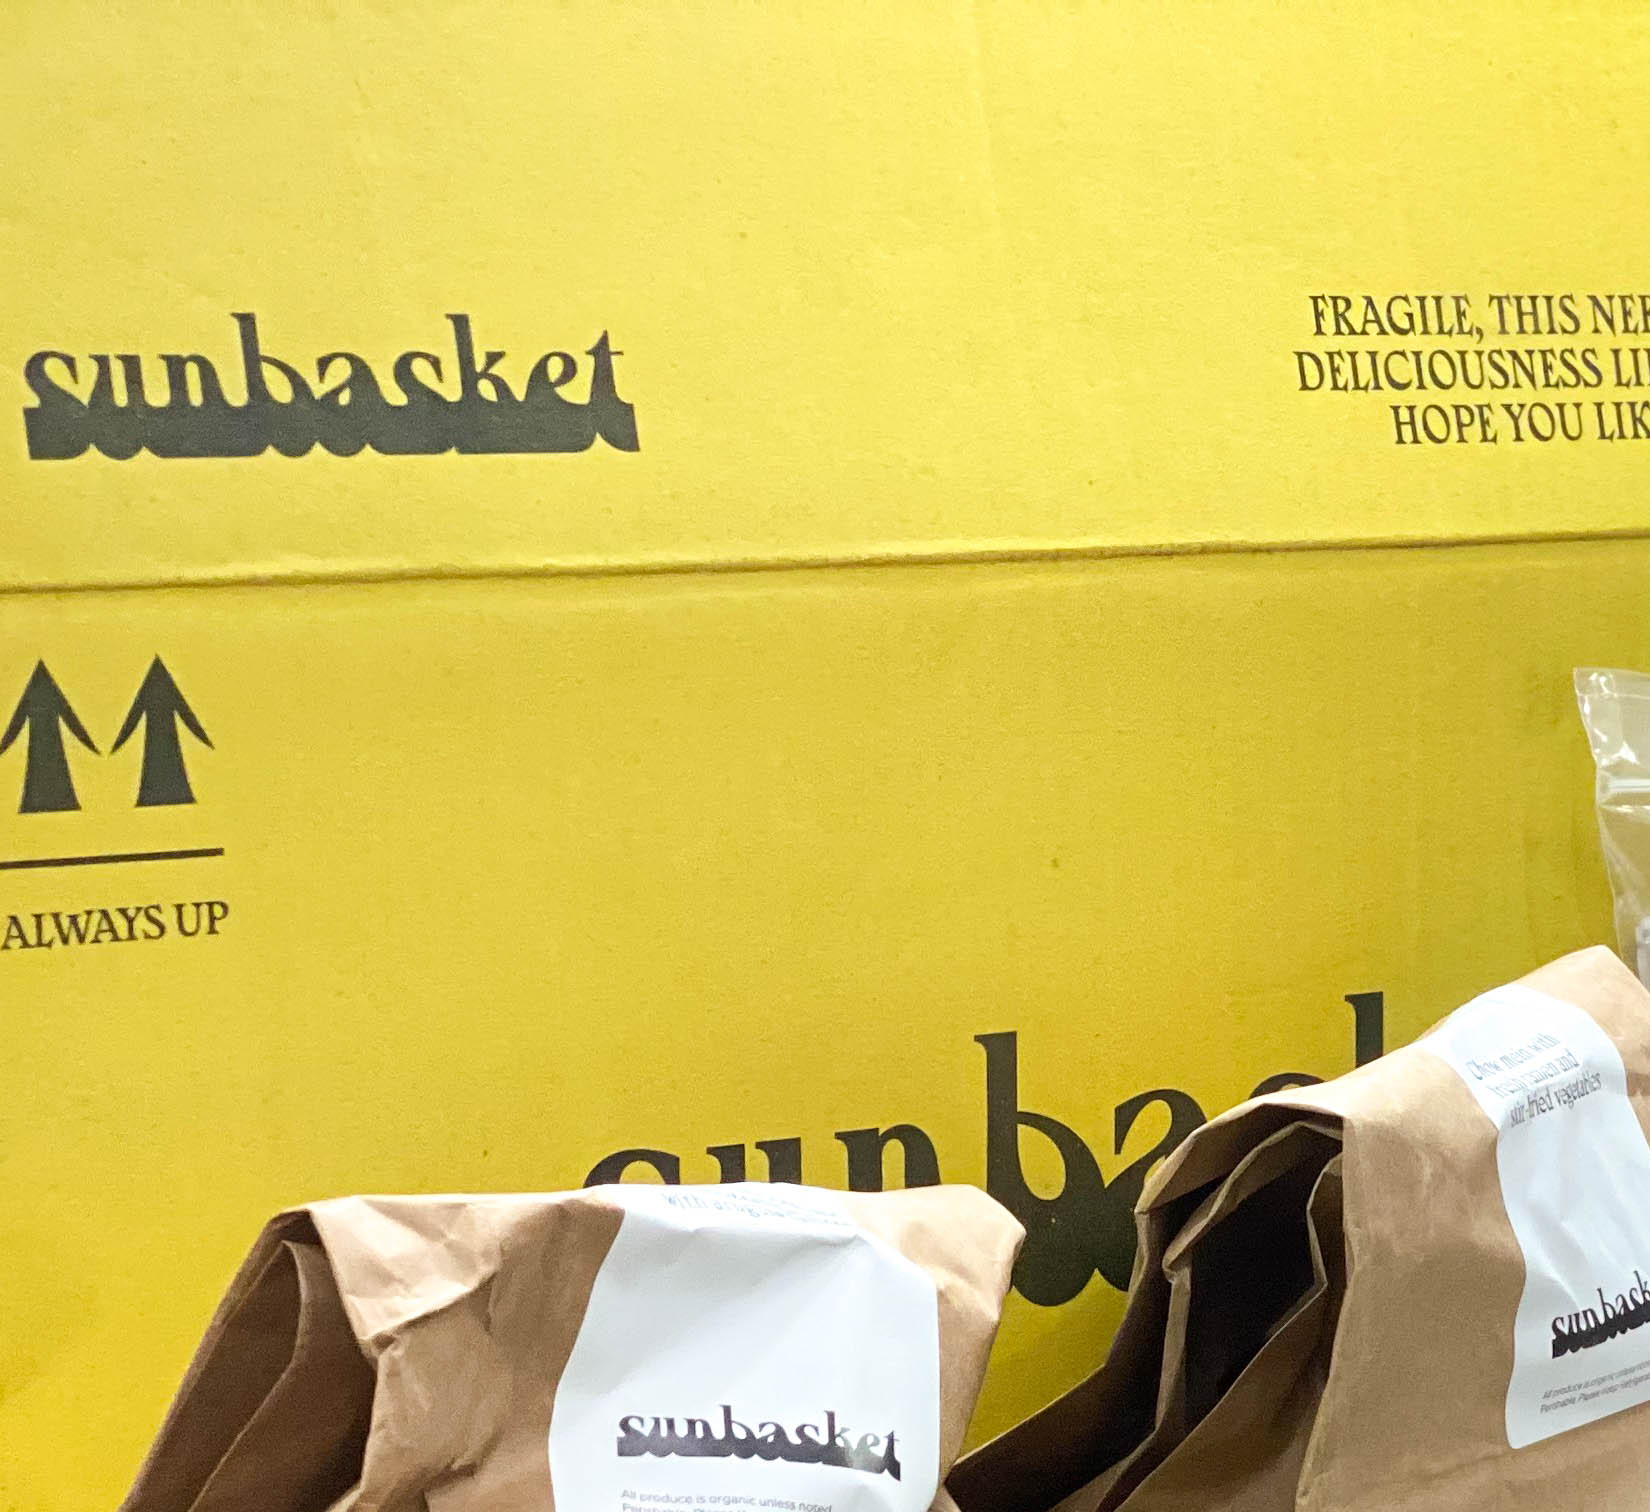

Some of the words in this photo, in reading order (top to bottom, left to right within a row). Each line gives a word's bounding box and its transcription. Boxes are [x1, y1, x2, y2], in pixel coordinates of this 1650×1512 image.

[1309, 294, 1485, 344] FRAGILE,
[1488, 294, 1581, 336] THIS
[23, 311, 640, 461] sunbasket
[1294, 349, 1603, 394] DELICIOUSNESS
[1391, 404, 1499, 446] HOPE
[1502, 402, 1584, 444] YOU
[0, 904, 167, 951] ALWAYS
[173, 899, 230, 937] UP
[616, 1404, 901, 1482] sunbasket
[639, 1491, 693, 1505] produce
[695, 1493, 706, 1504] is
[709, 1495, 757, 1508] organic
[758, 1497, 796, 1512] unless
